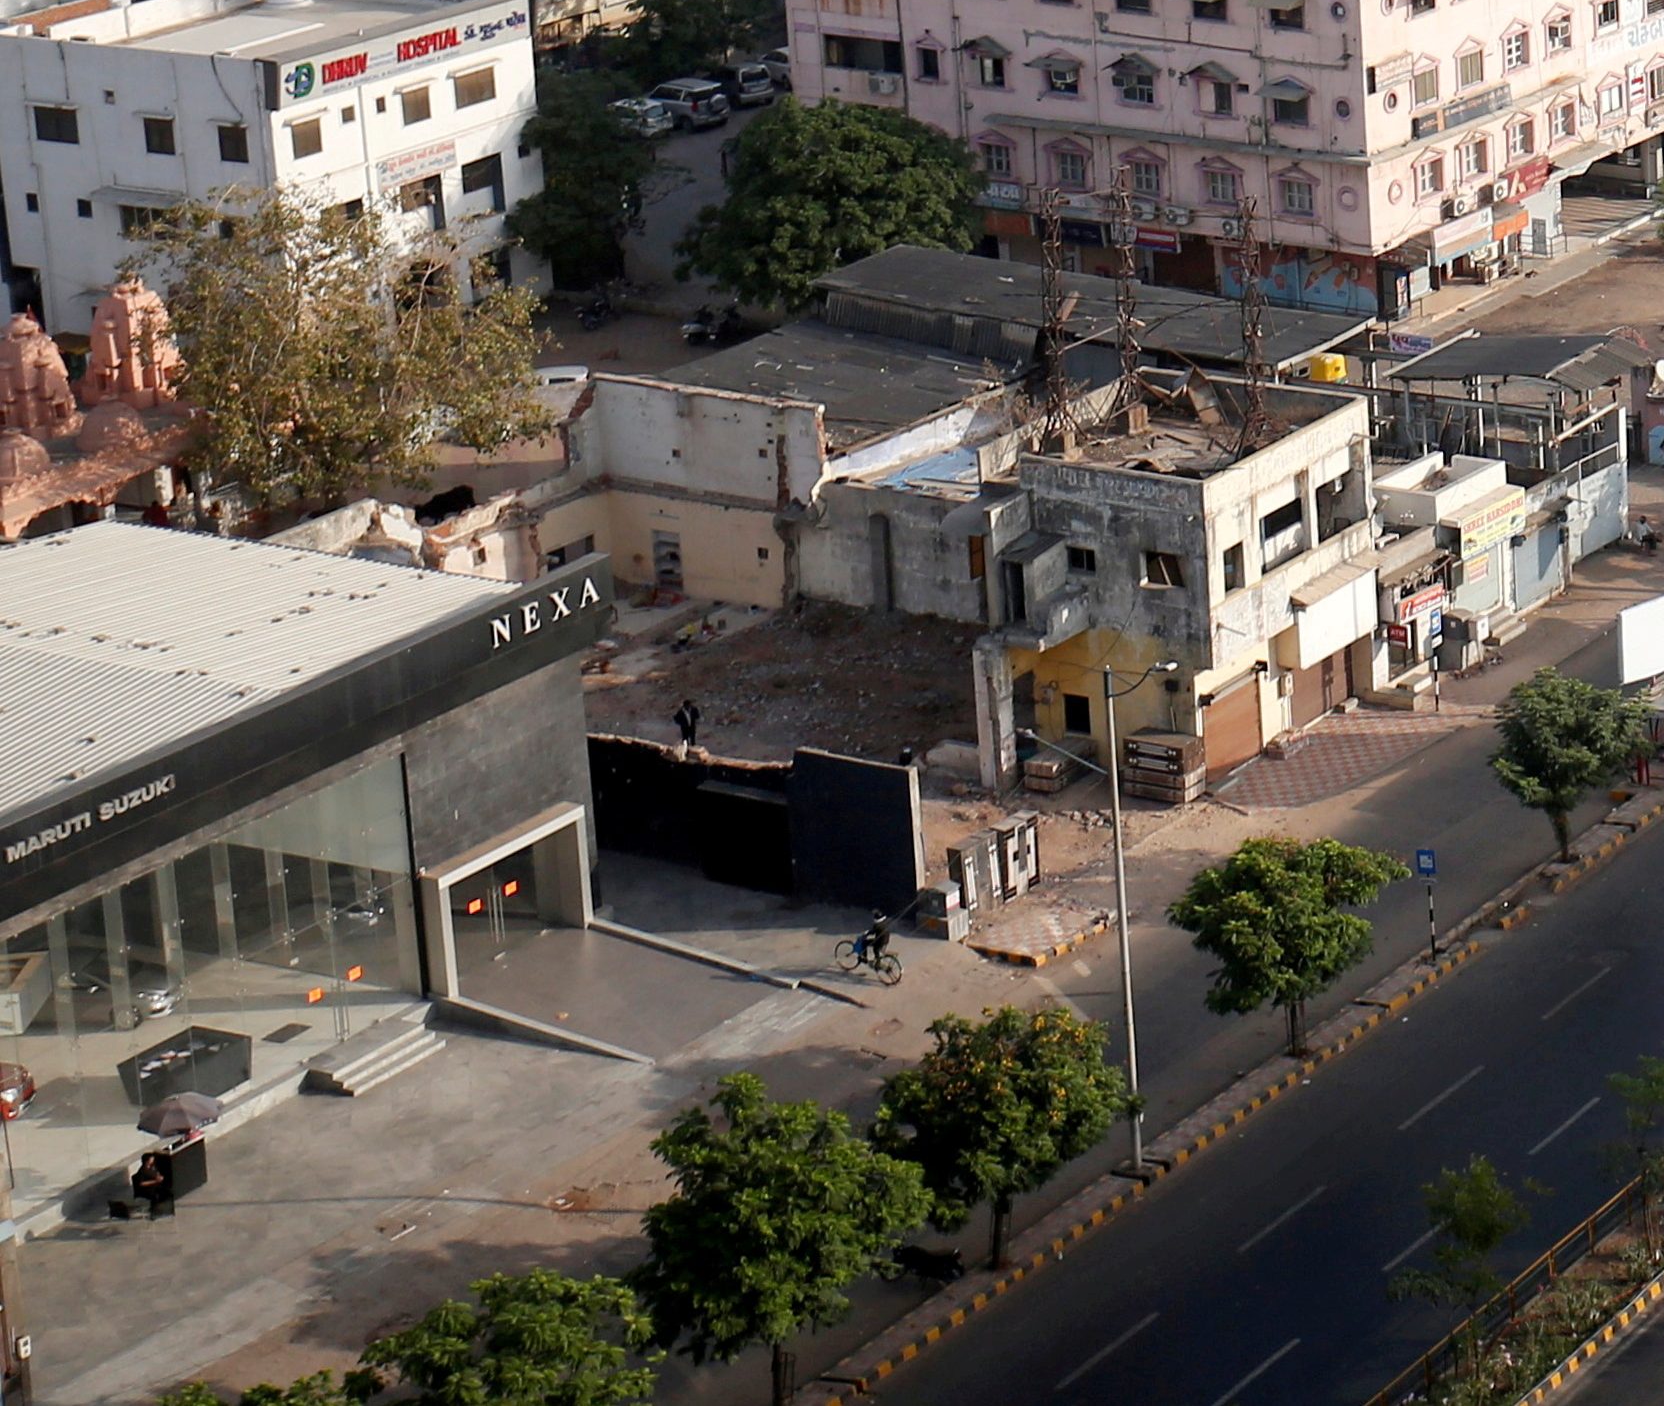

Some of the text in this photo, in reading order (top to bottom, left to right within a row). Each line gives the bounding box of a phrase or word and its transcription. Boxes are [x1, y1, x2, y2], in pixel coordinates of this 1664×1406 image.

[321, 26, 462, 85] DHRUV HOSPITAL
[490, 576, 600, 649] NEXA
[1390, 628, 1405, 637] ATM
[5, 773, 176, 863] MARUTI SUZUKI
